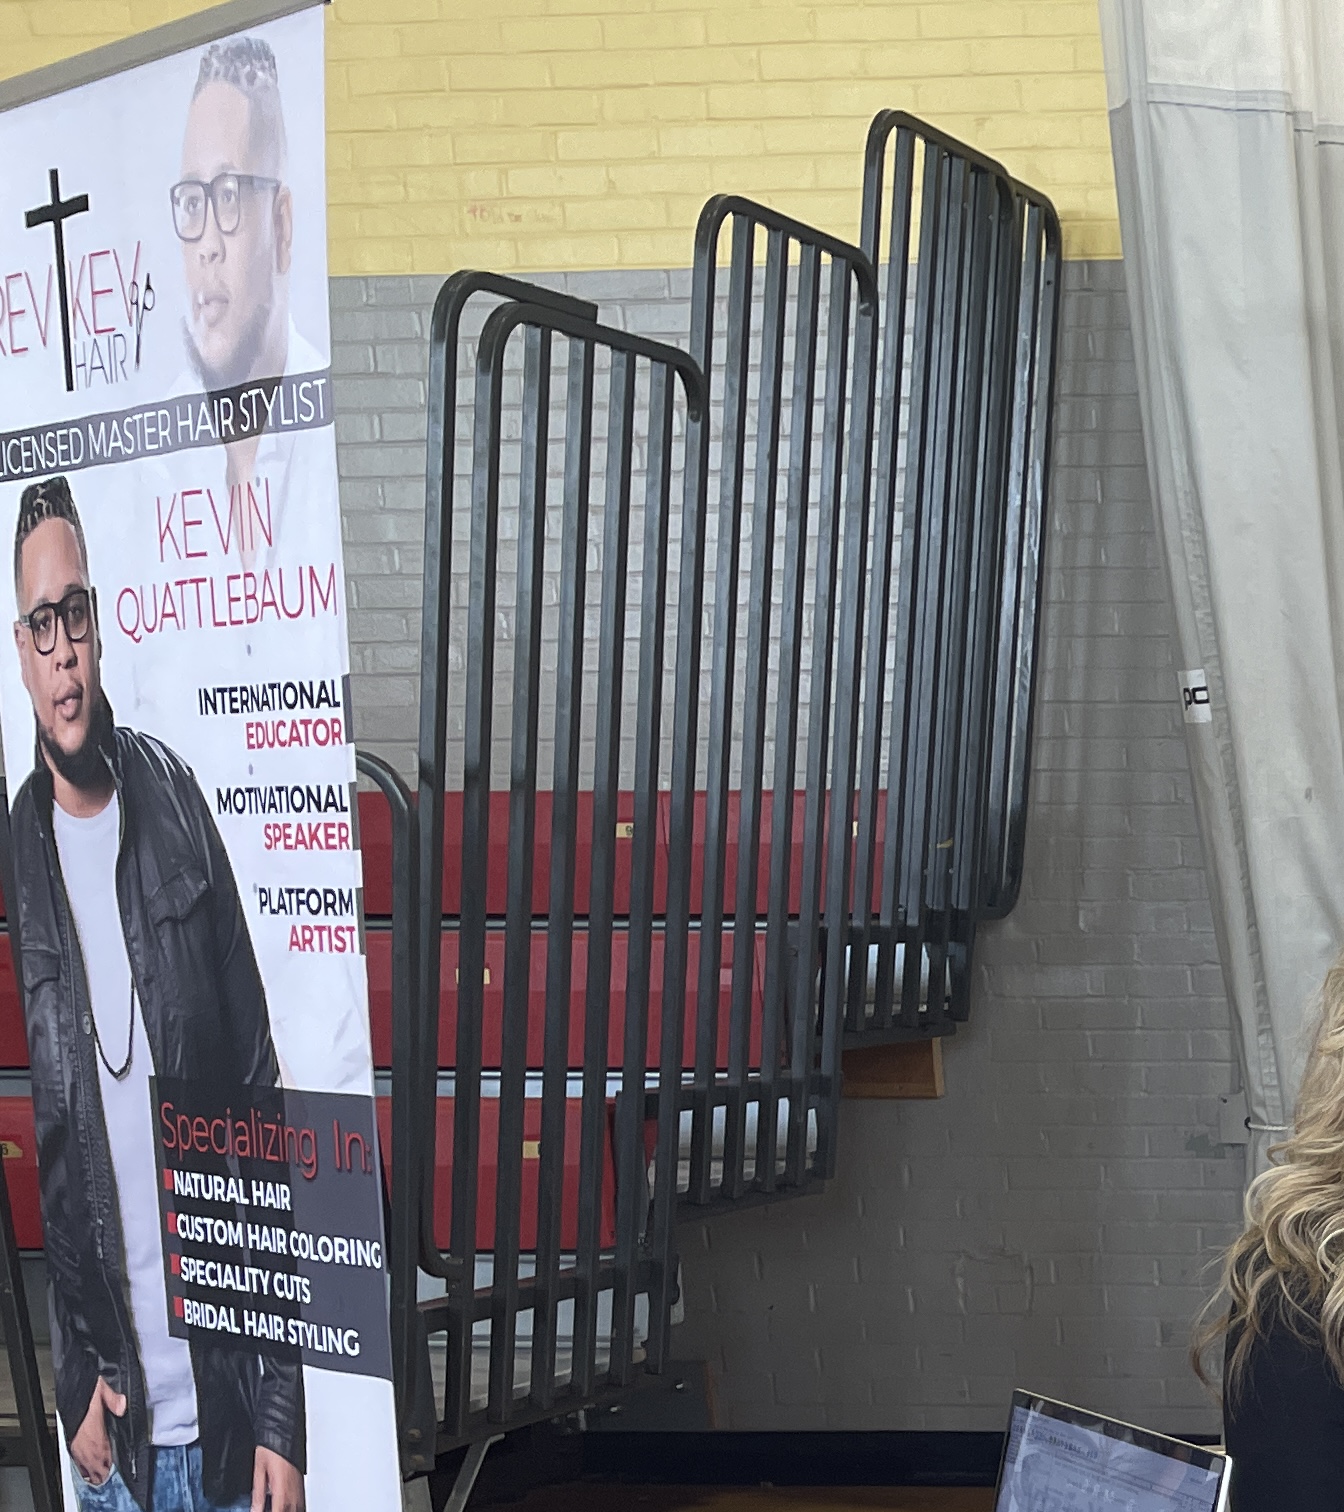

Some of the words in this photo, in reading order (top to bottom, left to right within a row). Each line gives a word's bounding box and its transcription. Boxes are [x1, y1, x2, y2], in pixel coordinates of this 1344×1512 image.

[68, 240, 141, 340] KEV
[73, 333, 128, 391] HAIR
[87, 408, 172, 460] MASTER
[176, 397, 236, 444] HAIR
[239, 378, 327, 432] STYLIST
[156, 476, 273, 563] KEVIN
[116, 562, 338, 643] QUATTLEBAUM
[198, 679, 341, 716] INTERNATIONAL
[245, 717, 344, 750] EDUCATOR
[216, 784, 349, 816] MOTIVATIONAL
[264, 821, 350, 852] SPEAKER
[258, 886, 354, 917] PLATFORM
[288, 924, 356, 953] ARTIST
[160, 1101, 318, 1180] Specializing
[332, 1118, 374, 1174] In:
[173, 1169, 250, 1206] NATURAL
[251, 1180, 292, 1212] HAIR
[176, 1213, 244, 1248] CUSTOM
[246, 1223, 288, 1256] HAIR
[289, 1230, 383, 1270] COLORING
[180, 1256, 270, 1296] SPECIALITY
[272, 1272, 312, 1305] CUTS
[183, 1298, 241, 1335] BRIDAL
[243, 1309, 285, 1343] HAIR
[287, 1319, 361, 1357] STYLING
